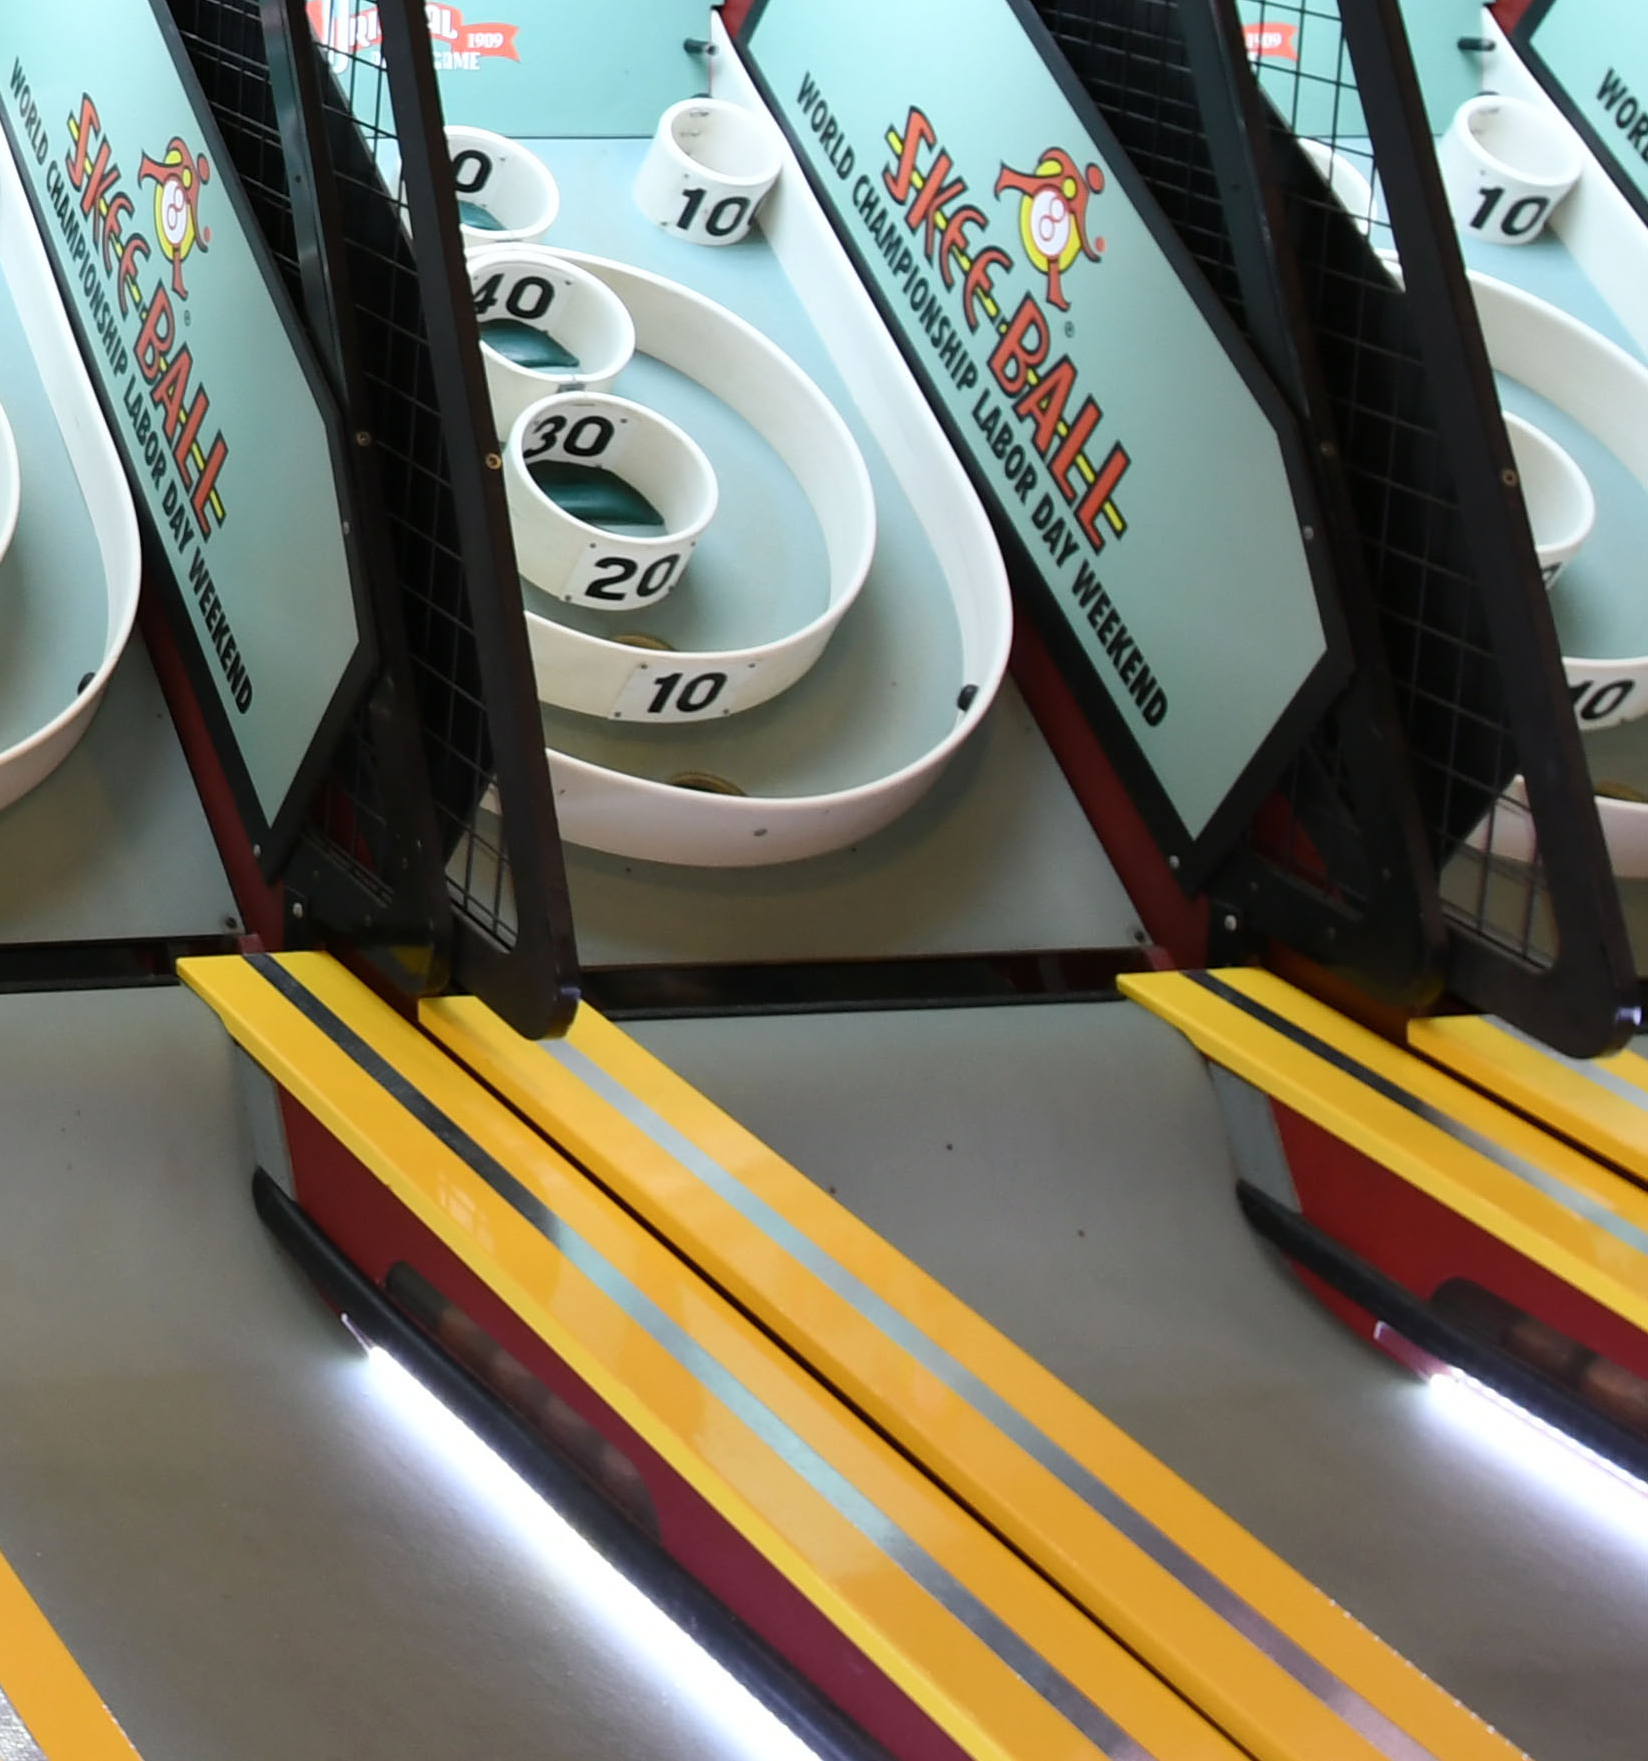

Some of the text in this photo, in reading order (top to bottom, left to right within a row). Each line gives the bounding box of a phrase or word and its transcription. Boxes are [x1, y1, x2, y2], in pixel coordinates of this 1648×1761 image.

[468, 33, 503, 50] 1909
[473, 276, 555, 319] 40
[9, 56, 254, 716] WORLD CHAMPIONSHIP LABOR DAY WEEKEND
[795, 71, 1170, 730] WORLD CHAMPIONSHIP LABOR DAY WEEKEND
[524, 415, 615, 458] 30
[584, 553, 681, 601] 20
[647, 673, 727, 714] 10
